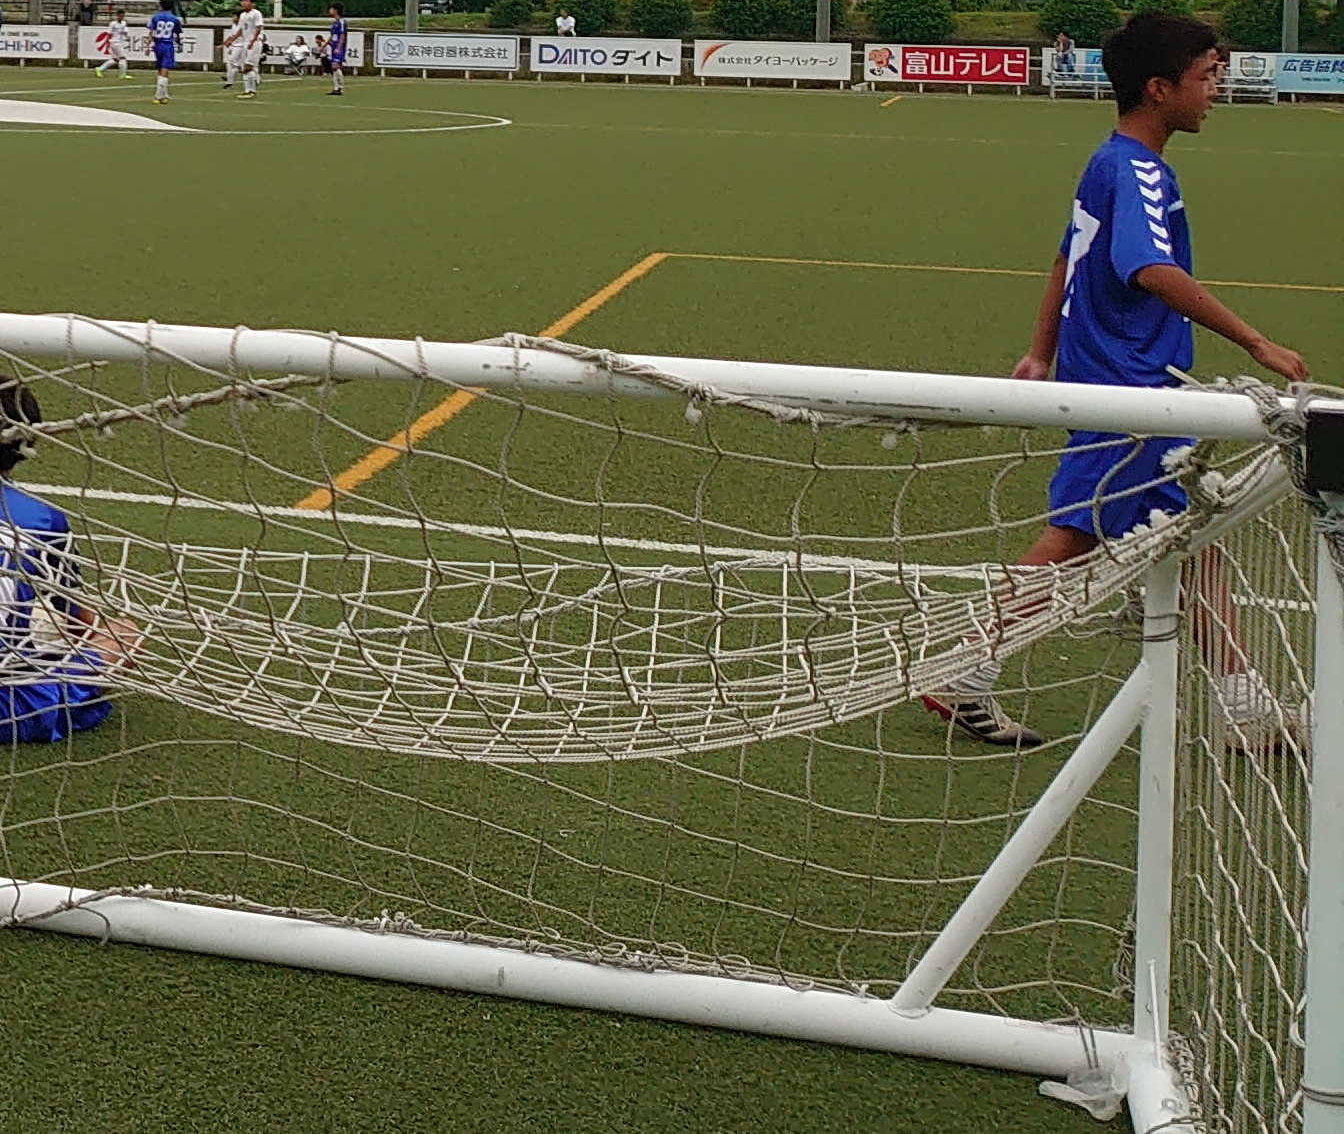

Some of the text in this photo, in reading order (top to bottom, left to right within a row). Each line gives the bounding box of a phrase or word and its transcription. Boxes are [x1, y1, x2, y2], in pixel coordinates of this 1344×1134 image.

[408, 45, 509, 60] 阪神容器株式会社
[538, 43, 674, 67] DAITO ダイト
[905, 50, 1025, 78] 富山テレビ
